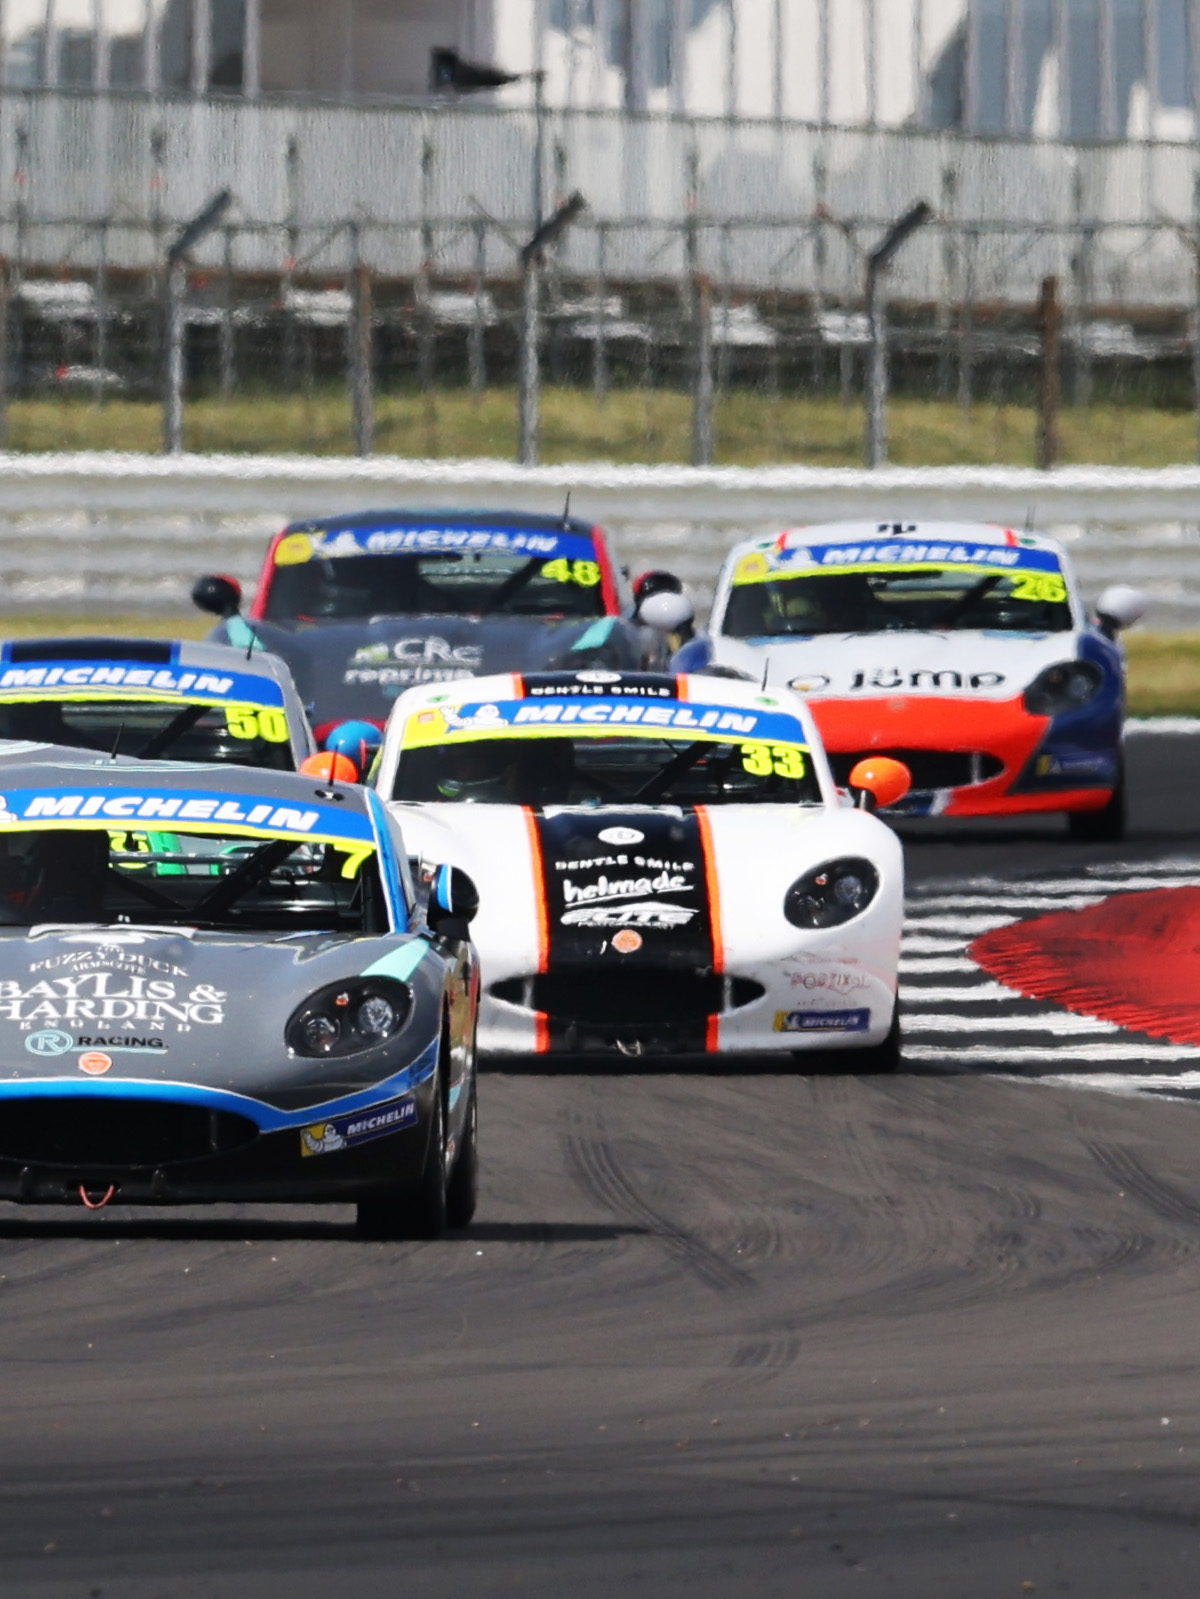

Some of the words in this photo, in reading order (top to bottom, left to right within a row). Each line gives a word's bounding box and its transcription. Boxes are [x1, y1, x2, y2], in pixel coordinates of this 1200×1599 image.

[367, 530, 558, 551] MICHELIN
[821, 545, 1020, 566] MICHELIN
[541, 557, 601, 586] 48
[1010, 573, 1067, 602] 26
[0, 667, 234, 694] MICHELIN
[225, 706, 289, 743] 50
[513, 704, 758, 733] MICHELIN
[741, 744, 805, 779] 33
[24, 796, 320, 831] MICHELIN
[334, 843, 373, 880] 7
[634, 856, 695, 872] SMILE
[563, 871, 686, 902] helmade
[29, 951, 106, 972] FUZZY
[118, 952, 189, 976] DUCK
[189, 984, 227, 1002] &
[346, 1104, 415, 1136] MICHELIN
